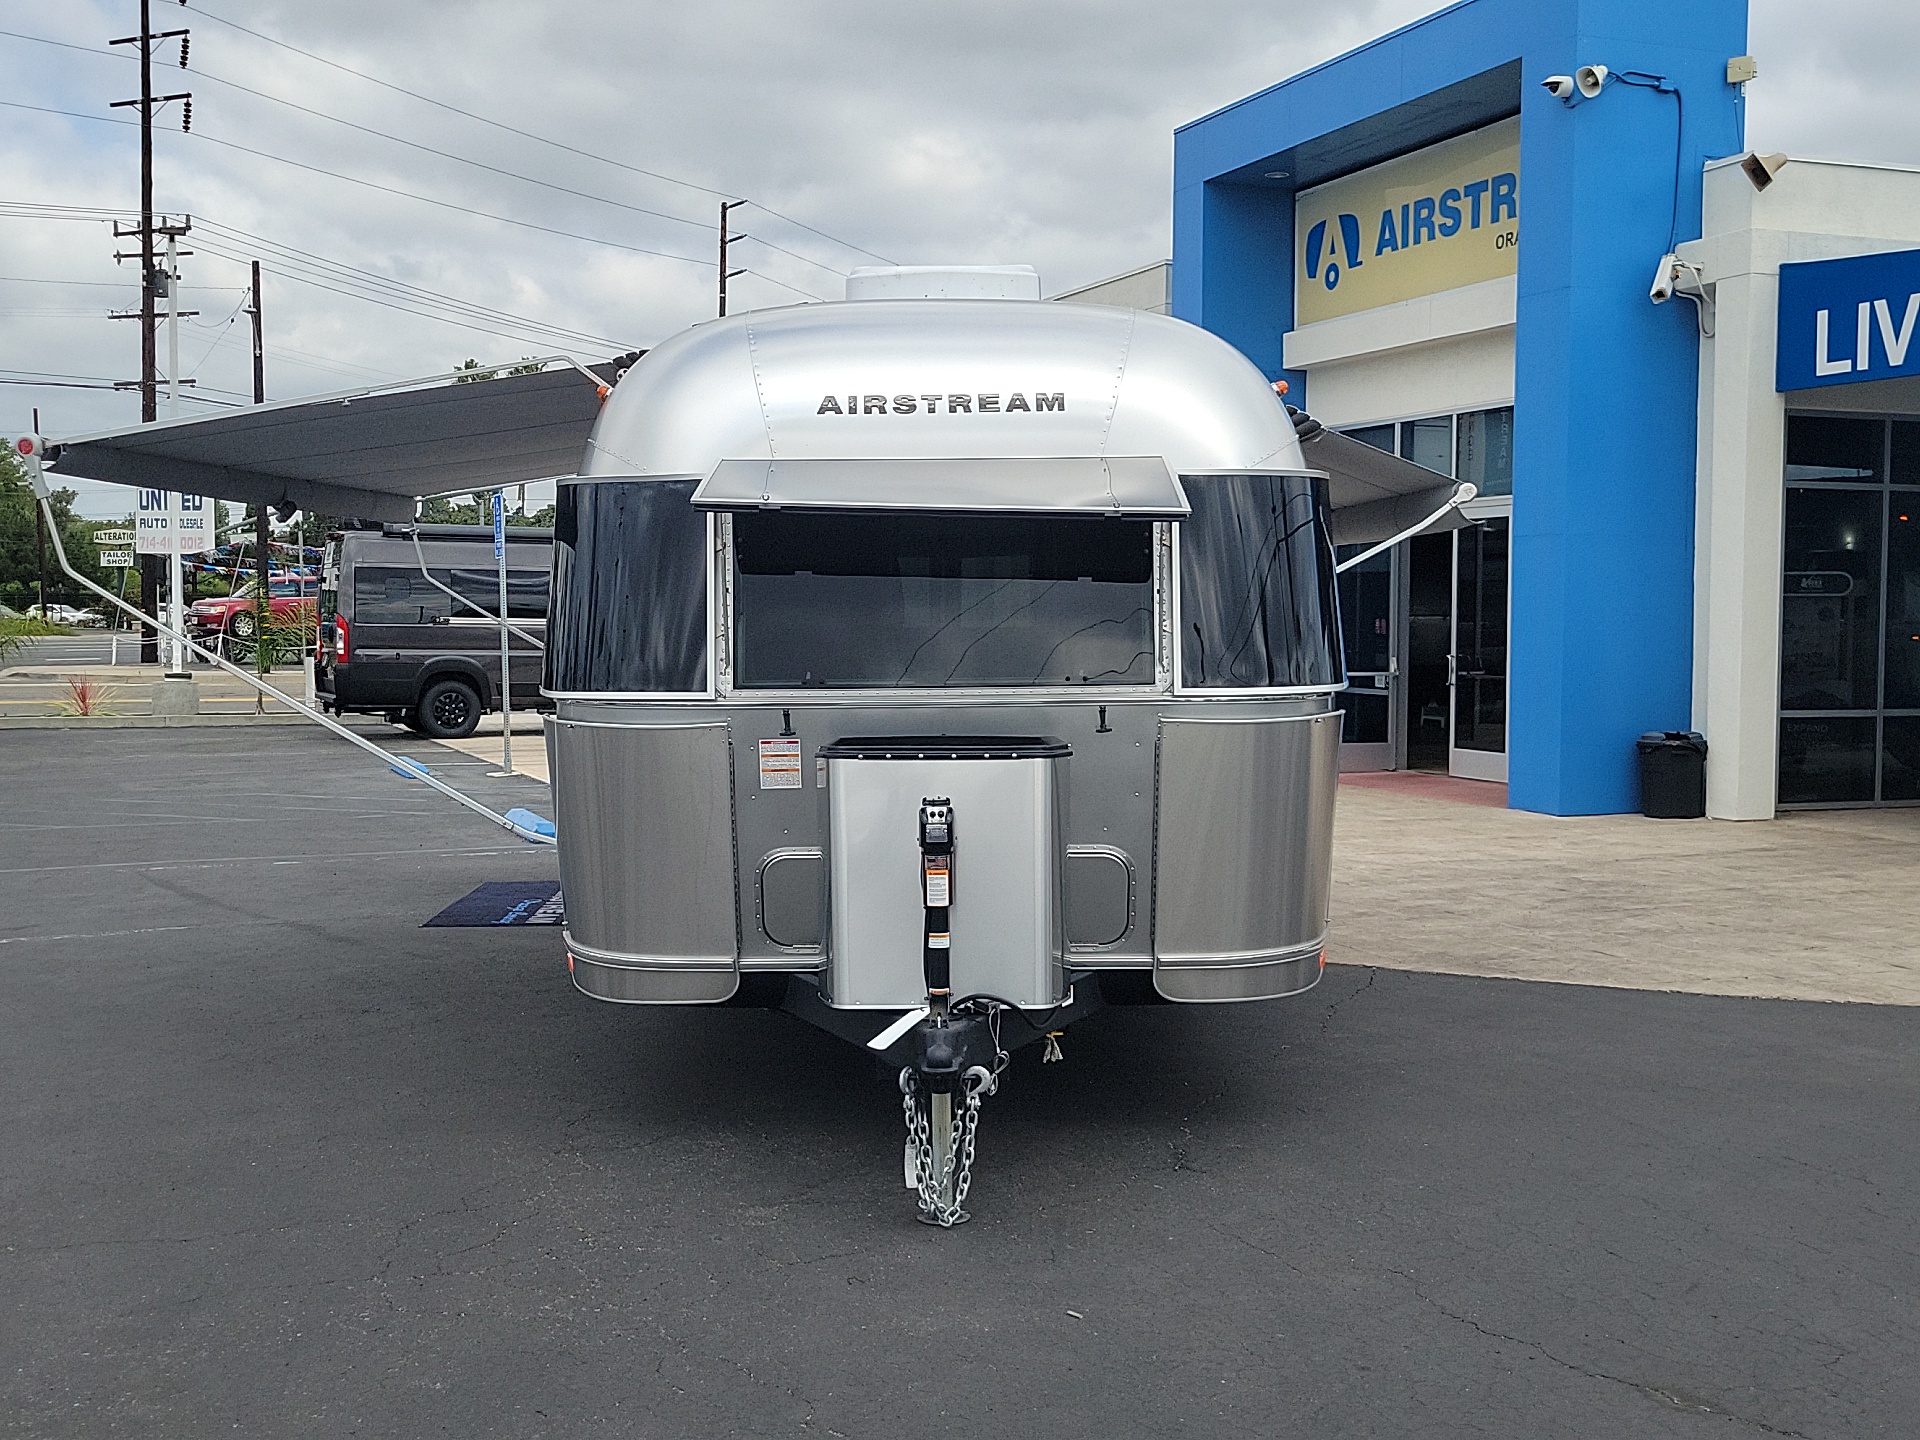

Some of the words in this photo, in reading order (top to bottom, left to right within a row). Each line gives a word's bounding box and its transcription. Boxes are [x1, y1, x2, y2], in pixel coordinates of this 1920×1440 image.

[1375, 172, 1517, 257] AIRSTR
[1815, 292, 1920, 376] LIV
[817, 392, 1065, 415] AIRSTREAM
[139, 489, 203, 511] UNIED
[139, 517, 168, 529] AUTO
